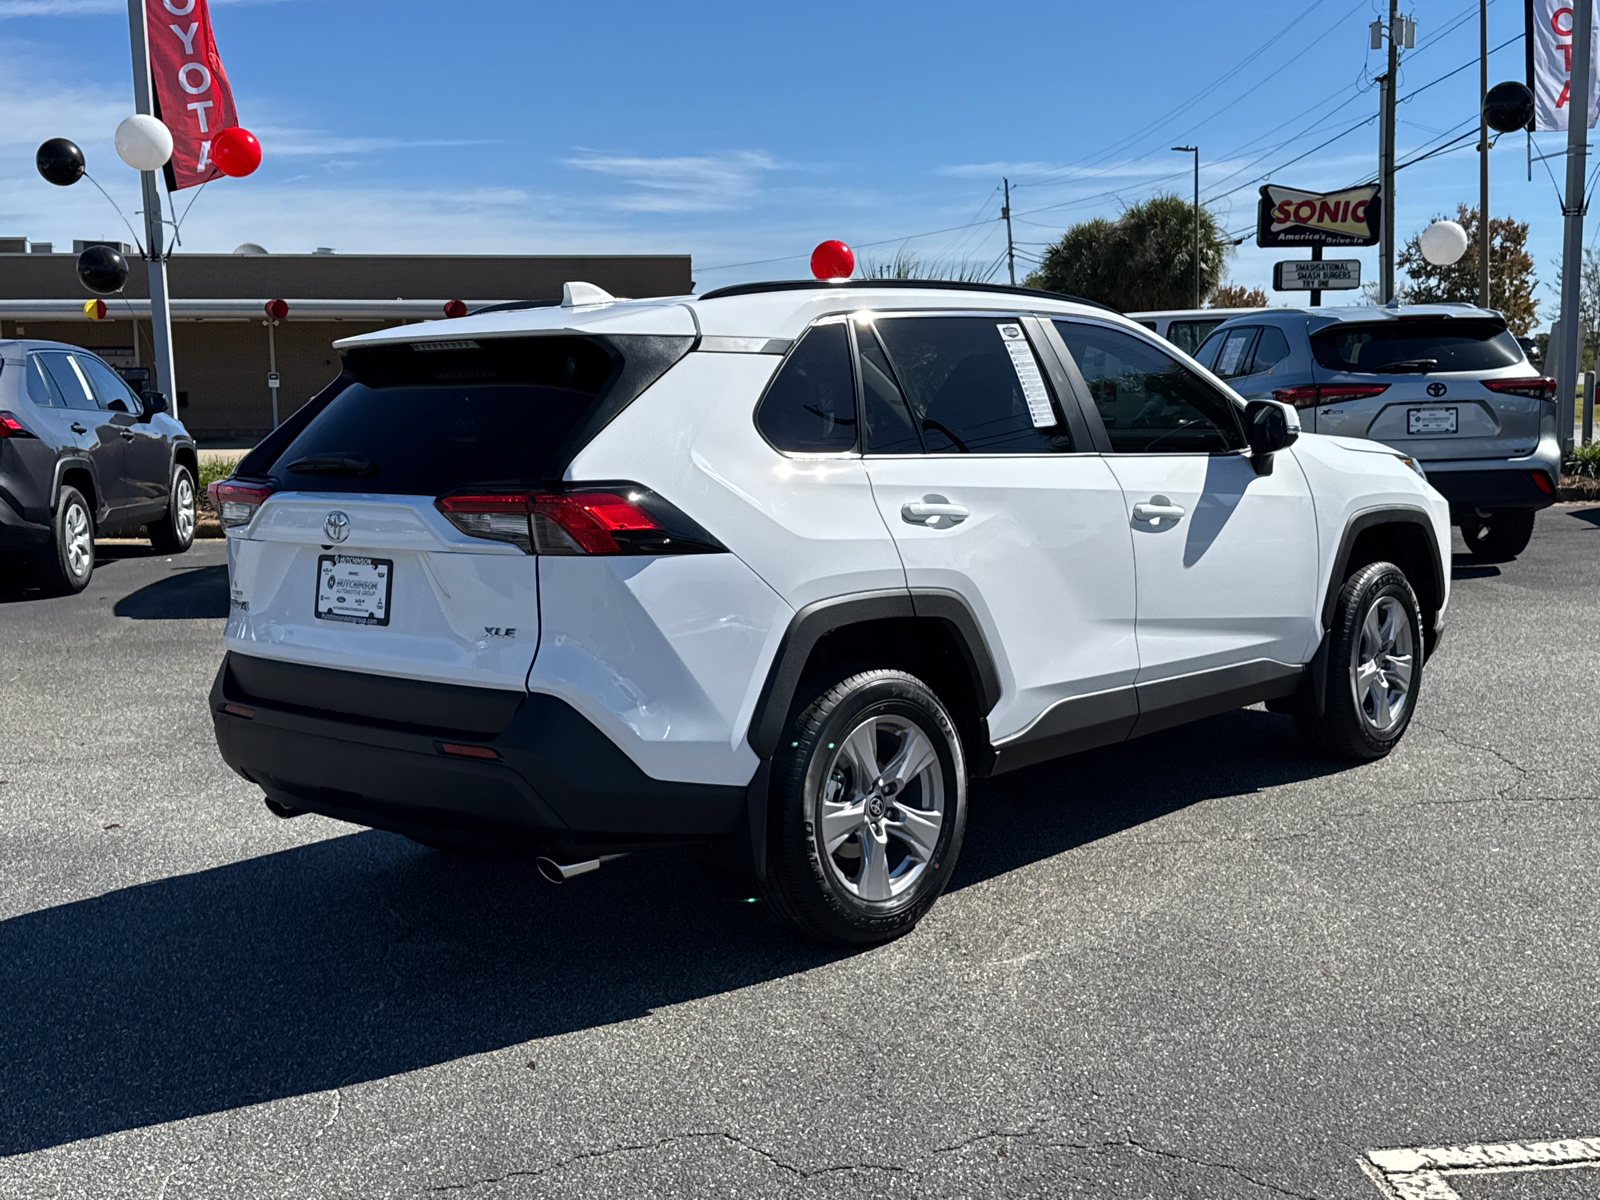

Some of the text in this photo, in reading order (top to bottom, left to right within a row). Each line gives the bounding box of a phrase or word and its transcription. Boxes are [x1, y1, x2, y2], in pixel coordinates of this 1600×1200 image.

[1275, 200, 1370, 224] SONIC
[1278, 232, 1326, 240] America's
[1295, 263, 1348, 271] SMASHSATIONAL
[1297, 271, 1351, 280] SMASH BURGERS
[340, 556, 372, 565] HUTCHINSON
[336, 581, 378, 590] HUTCHINSON
[336, 588, 361, 596] AUTOMOTIVE
[482, 626, 516, 638] XLE
